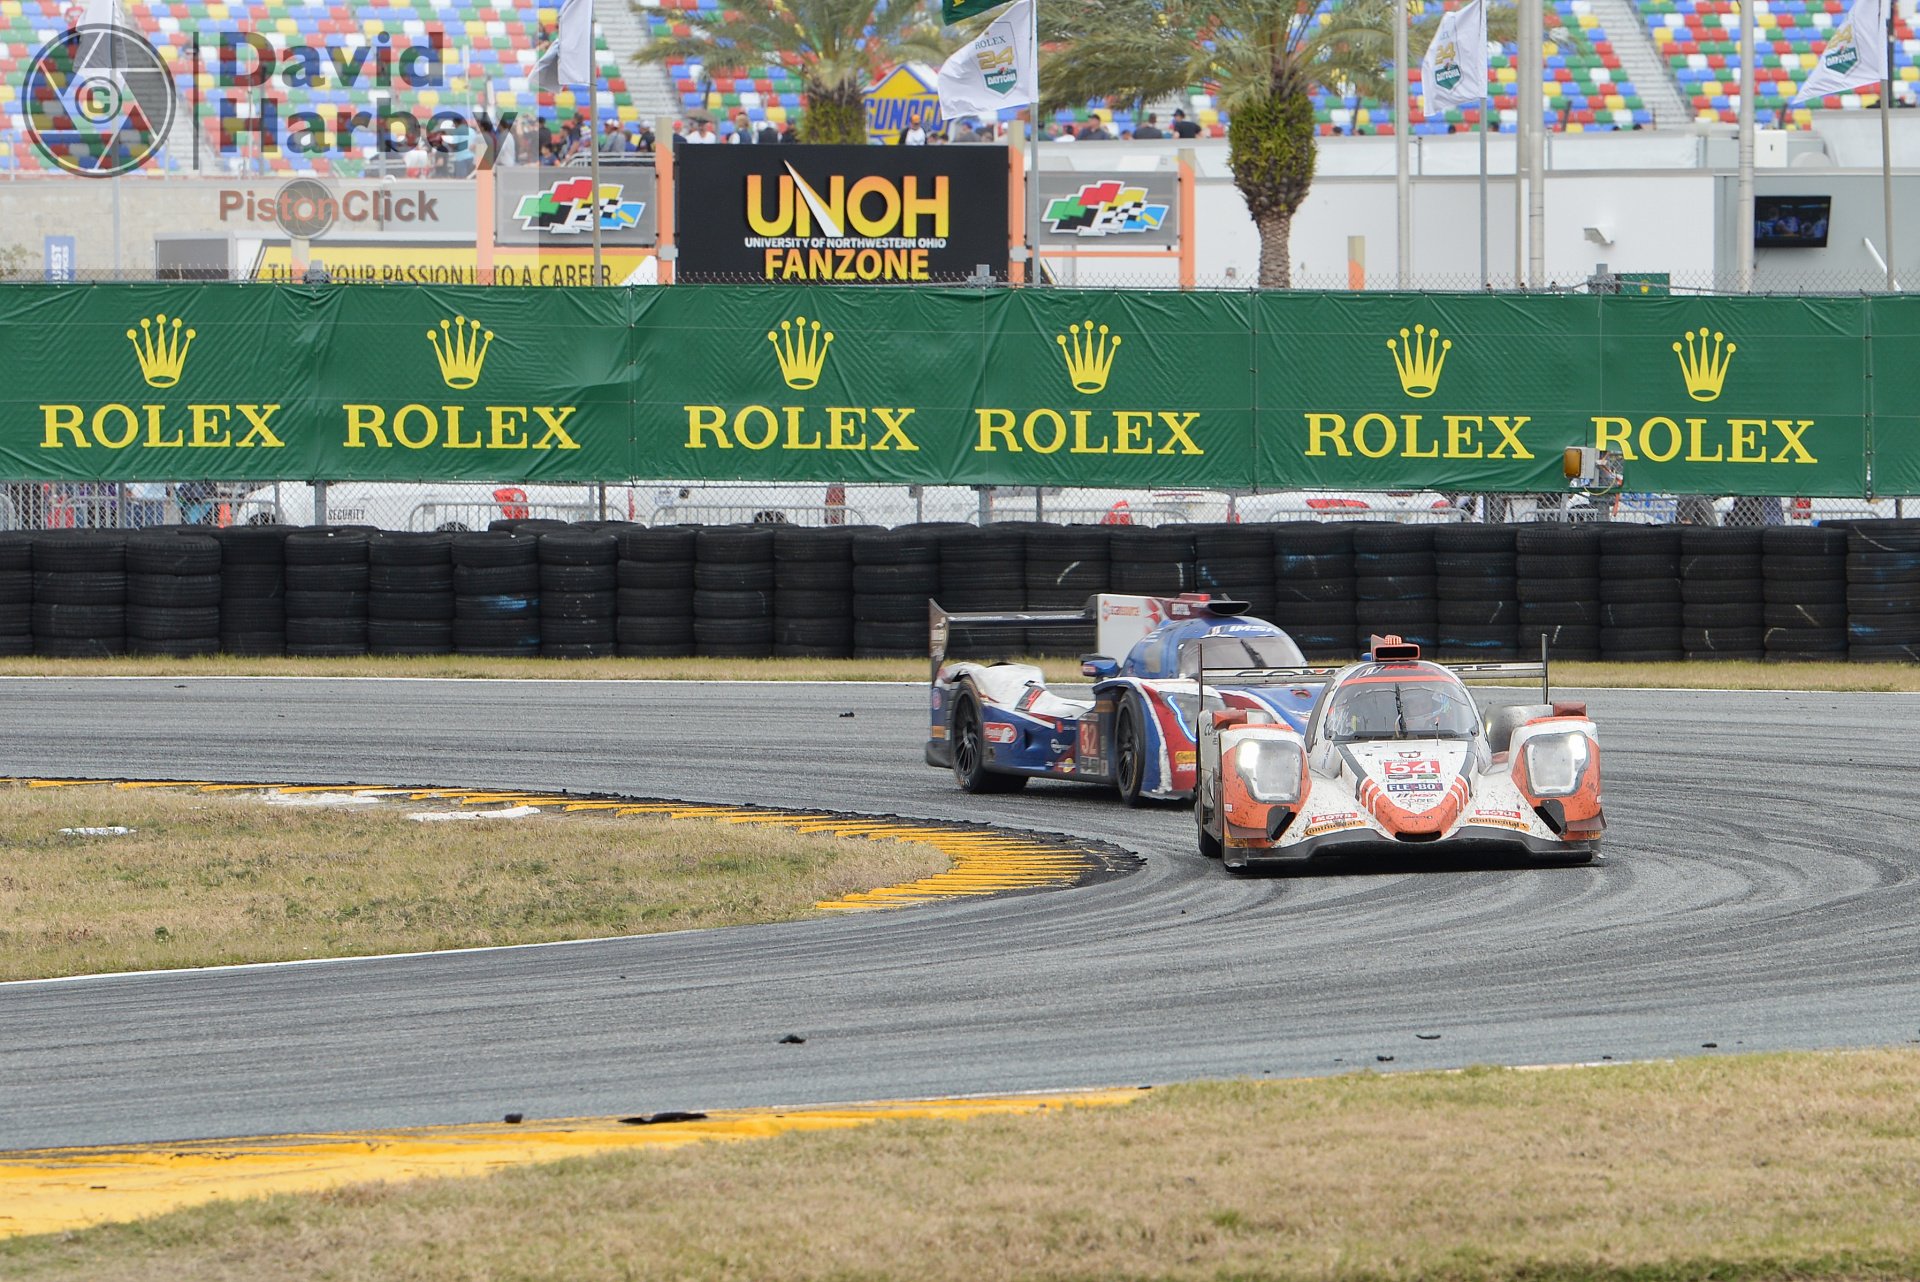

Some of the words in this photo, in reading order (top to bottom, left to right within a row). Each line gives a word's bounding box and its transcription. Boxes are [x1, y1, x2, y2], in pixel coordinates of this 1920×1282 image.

[975, 35, 1007, 50] ROLEX
[976, 46, 1014, 70] 24
[986, 72, 1017, 86] DAYTONA
[747, 160, 949, 238] UNOH
[744, 237, 810, 248] UNIVERSITY
[811, 238, 827, 248] OF
[828, 237, 917, 248] NORTHWESTERN
[918, 238, 947, 248] OHIO
[383, 264, 463, 285] PASSION
[522, 265, 532, 286] A
[765, 249, 929, 280] FANZONE
[42, 405, 285, 449] ROLEX
[345, 405, 580, 449] ROLEX
[685, 406, 918, 451] ROLEX
[977, 410, 1204, 455] ROLEX
[1307, 414, 1534, 459] ROLEX
[1591, 416, 1818, 464] ROLEX
[328, 508, 365, 520] SECURITY
[1081, 723, 1097, 755] 32
[1389, 761, 1436, 774] 54
[1480, 810, 1518, 818] MOTUL
